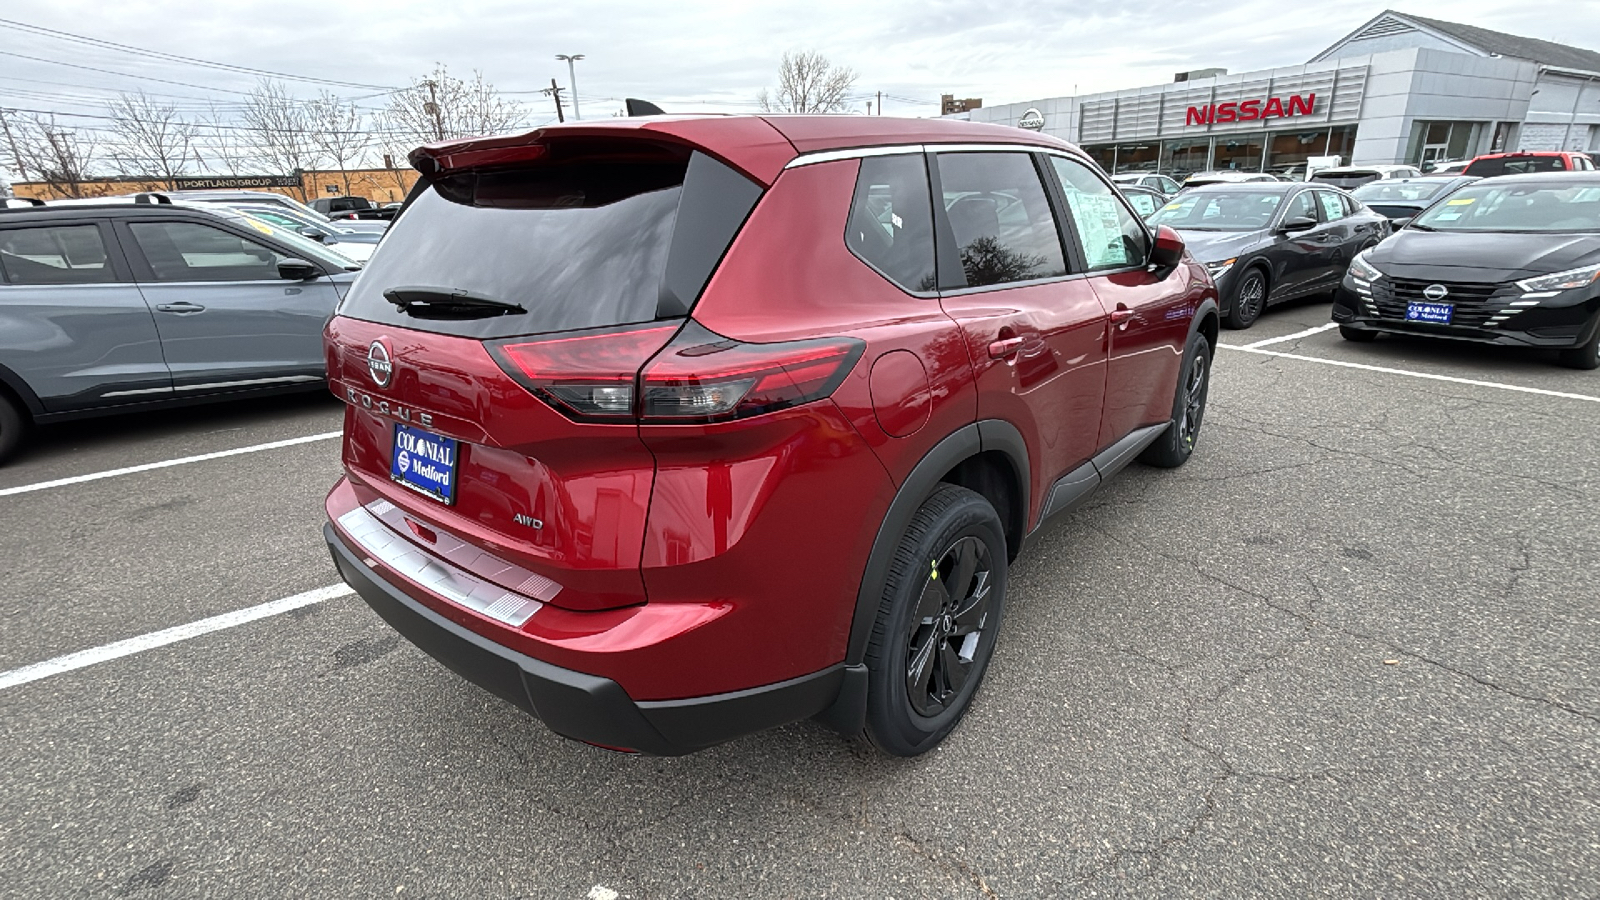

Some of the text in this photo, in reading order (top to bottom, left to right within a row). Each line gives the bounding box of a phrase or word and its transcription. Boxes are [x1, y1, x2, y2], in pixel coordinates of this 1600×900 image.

[1186, 93, 1316, 126] NISSAN
[184, 179, 237, 188] PORTLAND
[238, 178, 272, 187] GROUP
[346, 387, 433, 428] ROGUE
[397, 431, 454, 467] COLONIAL
[412, 458, 449, 486] Medford
[512, 512, 543, 530] AWD
